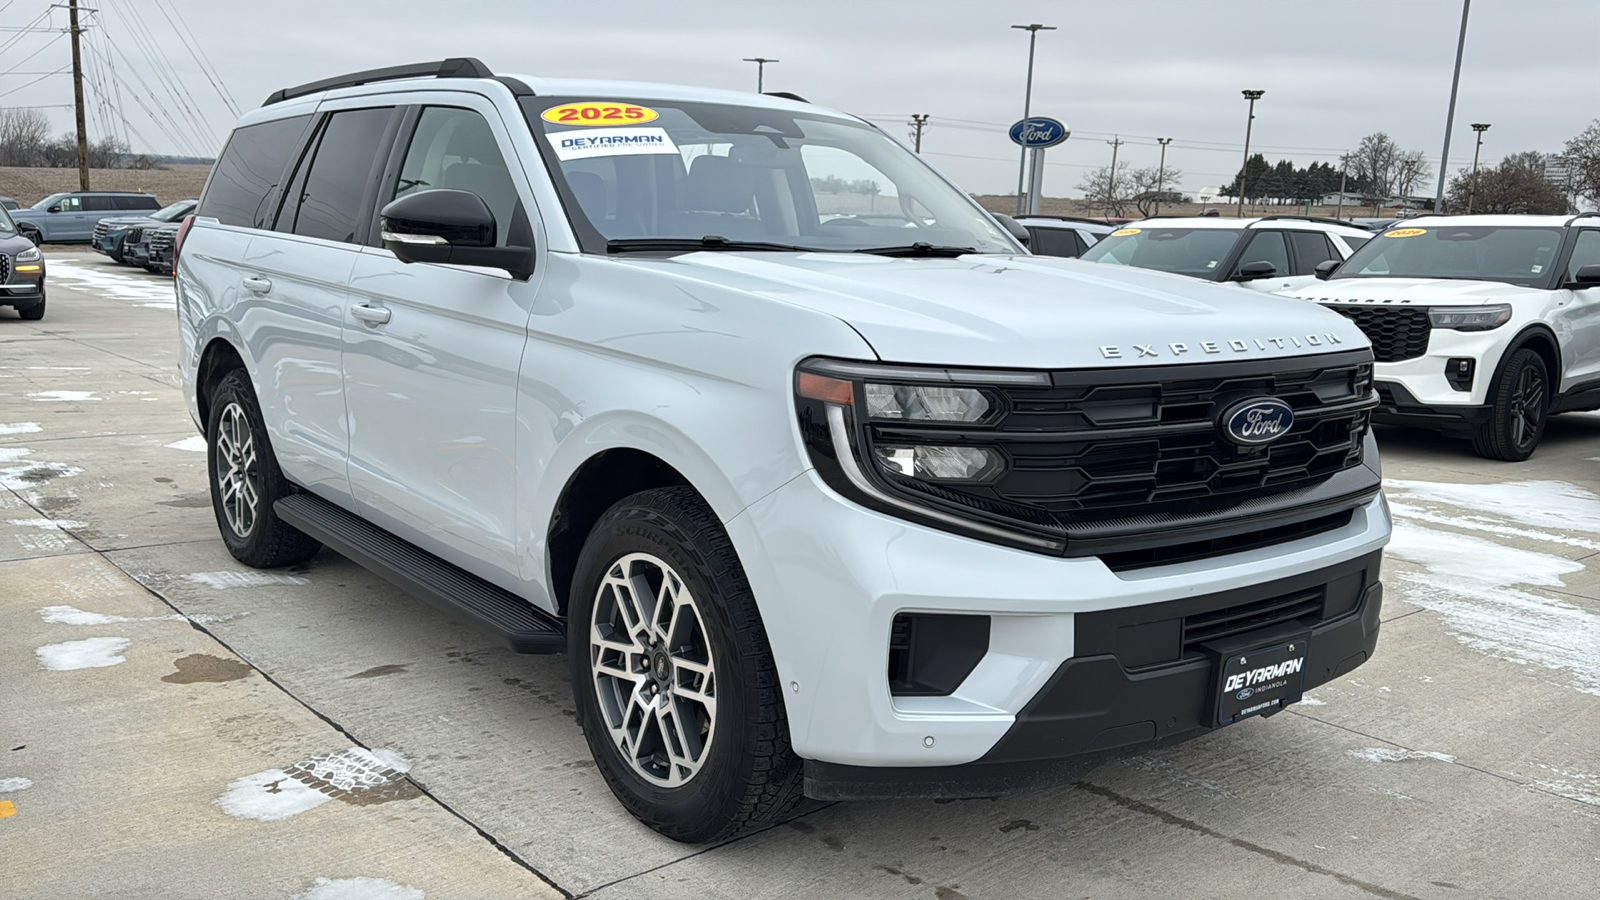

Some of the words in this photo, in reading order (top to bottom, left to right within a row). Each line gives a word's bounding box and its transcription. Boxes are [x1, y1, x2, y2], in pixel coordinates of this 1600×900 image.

[558, 107, 644, 121] 2025
[561, 135, 663, 148] DEYARMAN
[1018, 122, 1053, 141] Ford
[1098, 332, 1342, 358] EXPEDITION
[1242, 408, 1282, 437] Ford
[616, 525, 694, 580] SCORPION
[1224, 657, 1304, 693] DEYARMAN
[1255, 679, 1288, 693] INDIANOLA
